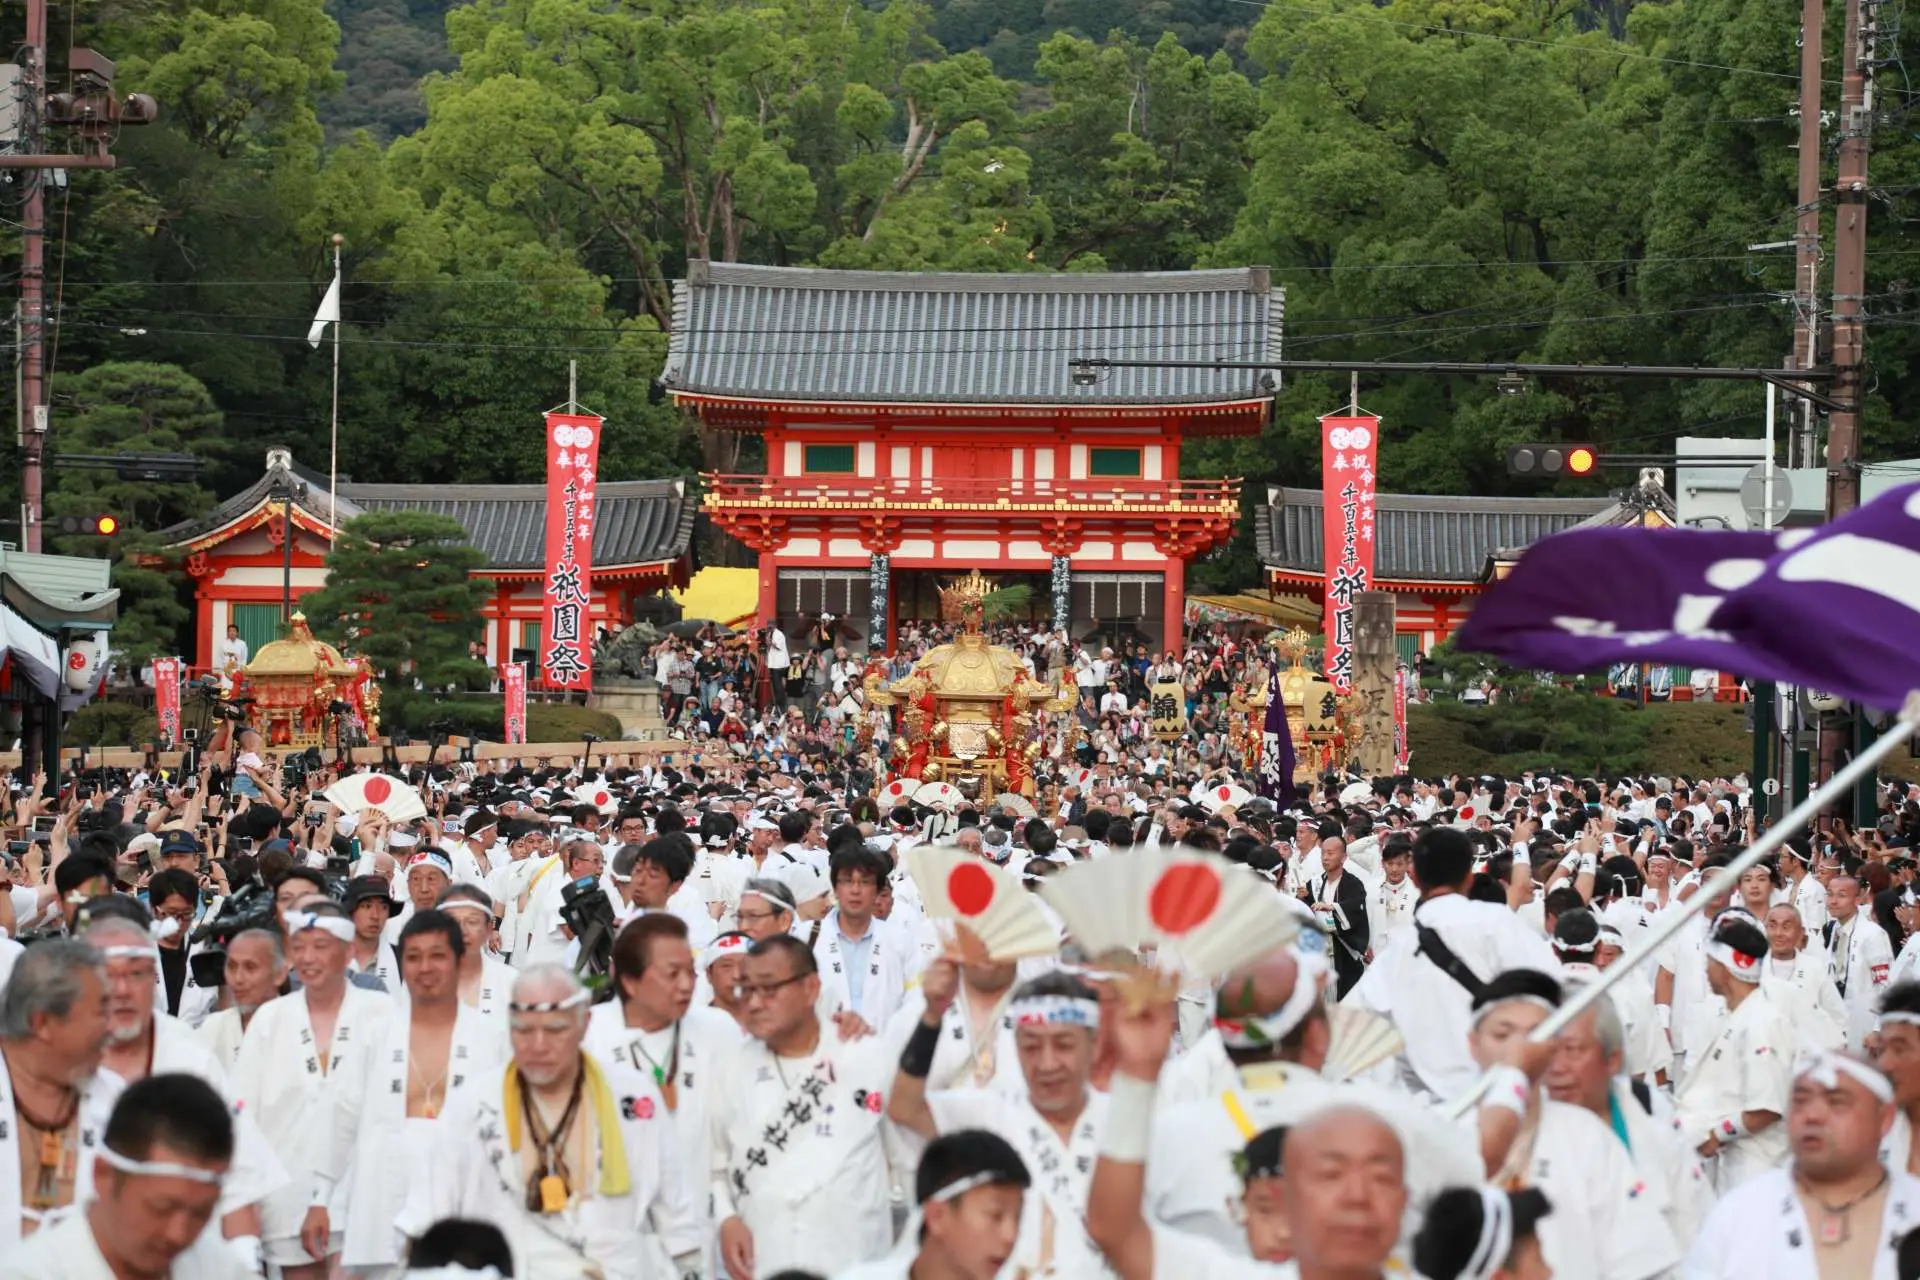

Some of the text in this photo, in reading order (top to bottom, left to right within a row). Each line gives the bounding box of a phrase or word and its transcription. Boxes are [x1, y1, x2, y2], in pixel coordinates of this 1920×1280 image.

[544, 563, 589, 685] 祇園祭
[1151, 691, 1179, 722] 錦
[1353, 660, 1393, 773] 八坂神
